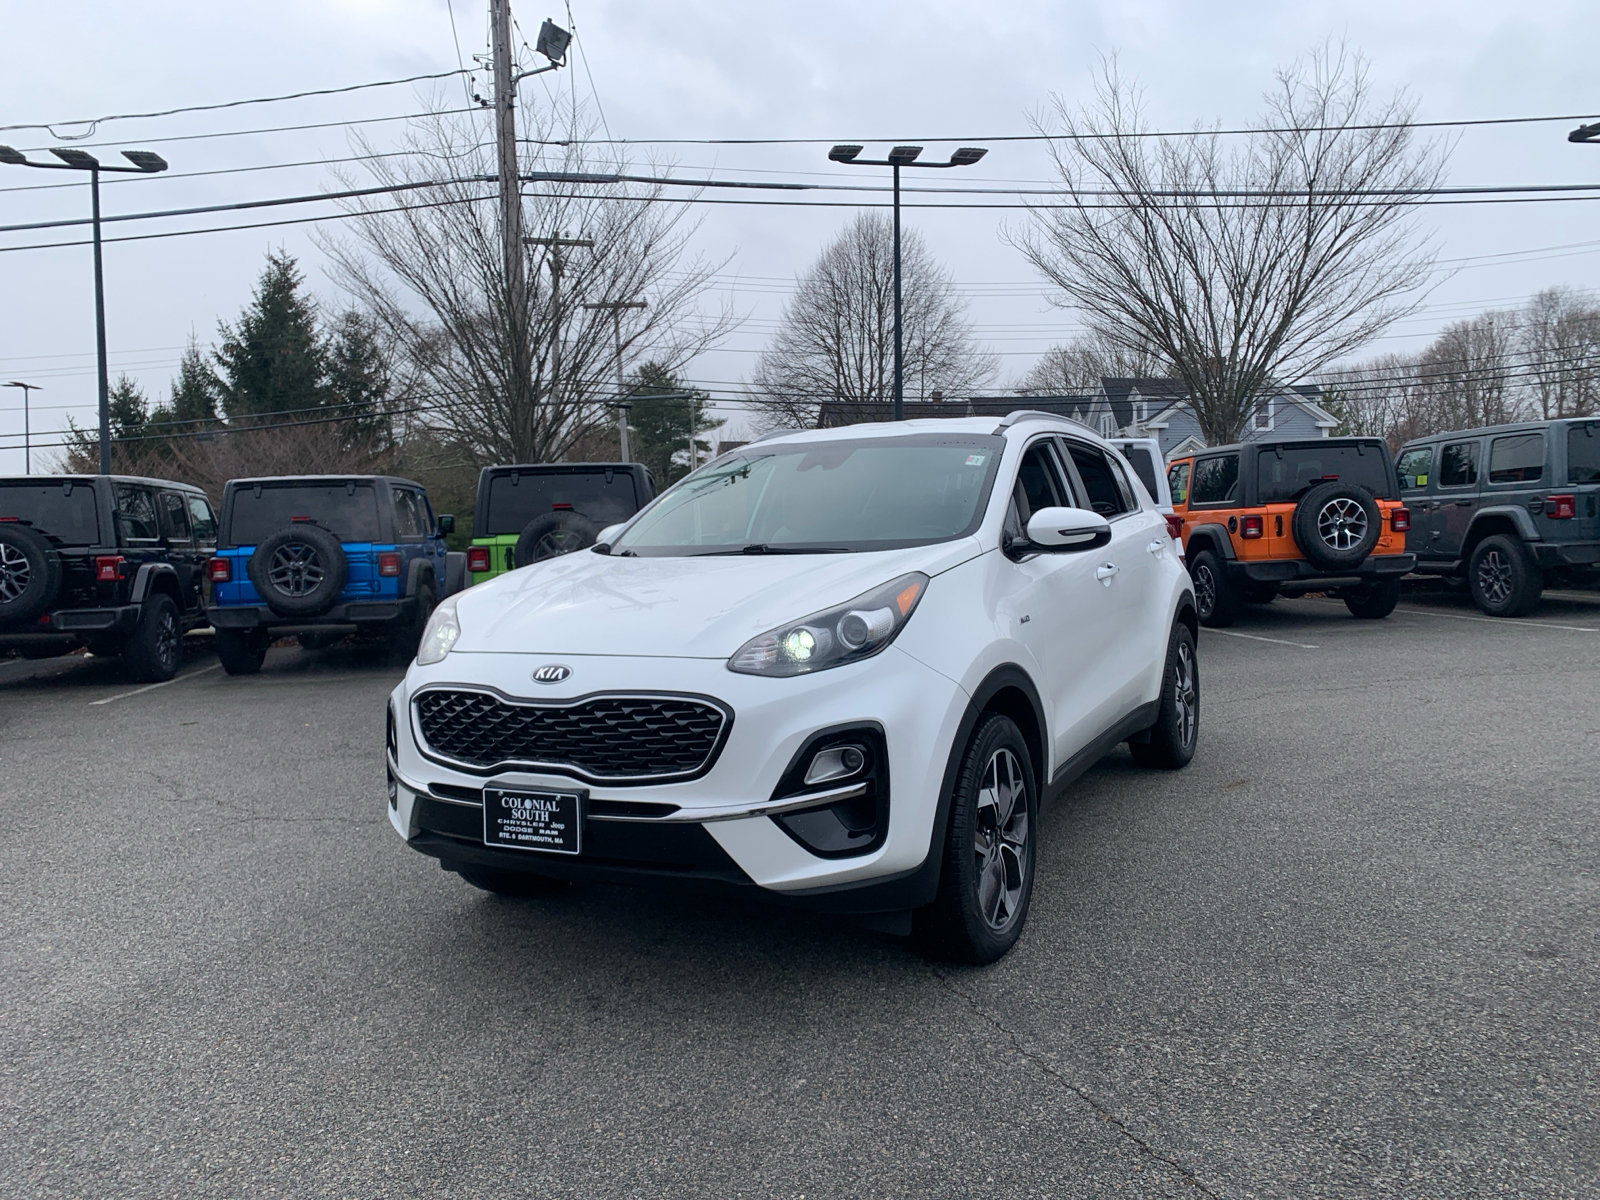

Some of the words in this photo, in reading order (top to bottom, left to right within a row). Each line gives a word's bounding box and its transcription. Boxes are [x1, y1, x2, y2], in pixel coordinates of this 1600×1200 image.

[535, 667, 564, 679] KIA
[501, 796, 560, 812] COLONIAL
[511, 808, 549, 822] SOUTH
[497, 818, 545, 827] CHRYSLER
[550, 821, 565, 830] Jeep
[503, 825, 534, 833] DODGE
[518, 834, 553, 843] DARTMOUTH,
